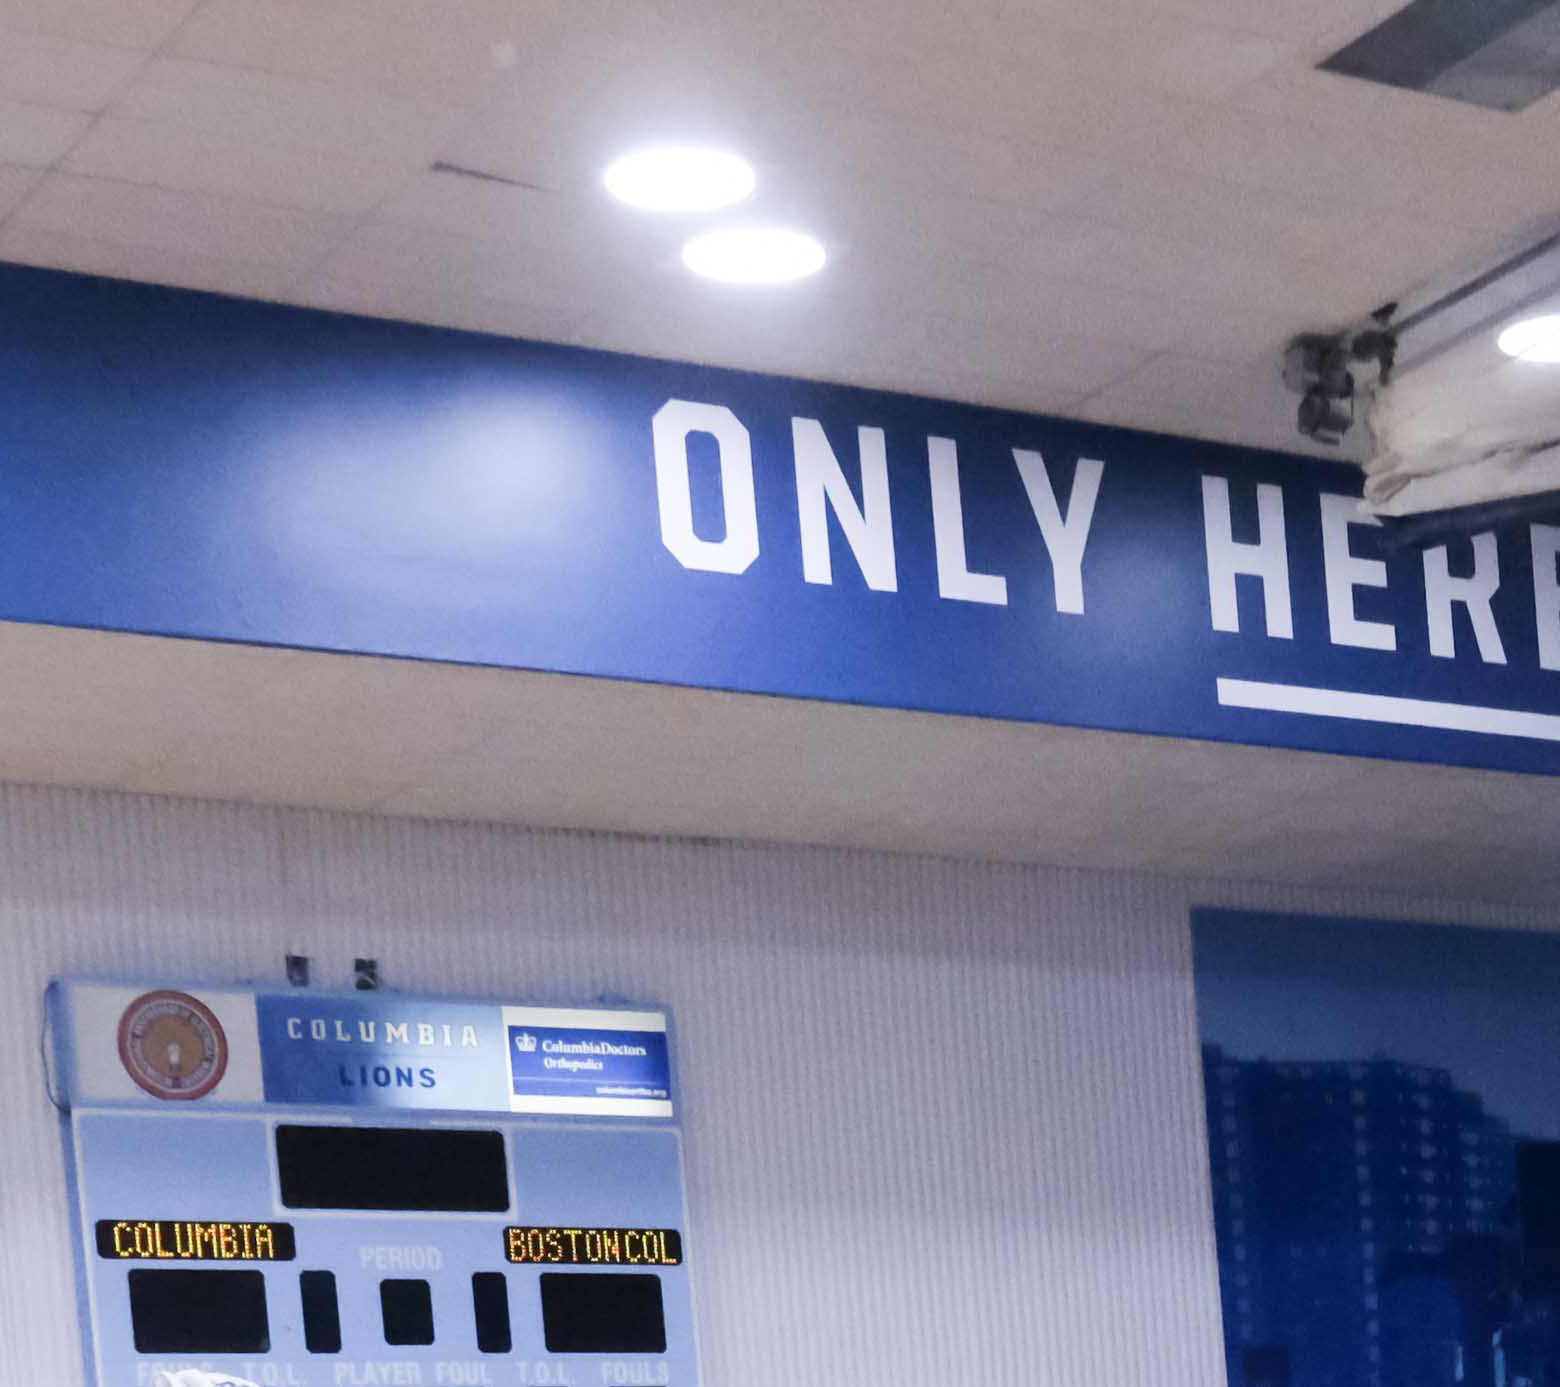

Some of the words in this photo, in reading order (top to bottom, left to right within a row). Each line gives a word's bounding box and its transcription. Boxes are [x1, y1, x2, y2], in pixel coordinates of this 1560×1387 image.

[651, 398, 1105, 615] ONLY
[287, 1018, 478, 1047] COLUMBIA
[542, 1039, 647, 1056] ColumbiaDoctors
[340, 1065, 436, 1088] LIONS
[113, 1222, 274, 1260] COLUMBIA
[360, 1246, 442, 1271] PERIOD
[335, 1361, 423, 1385] PLAYER
[436, 1360, 493, 1384] FOUL
[601, 1361, 669, 1384] FOULS
